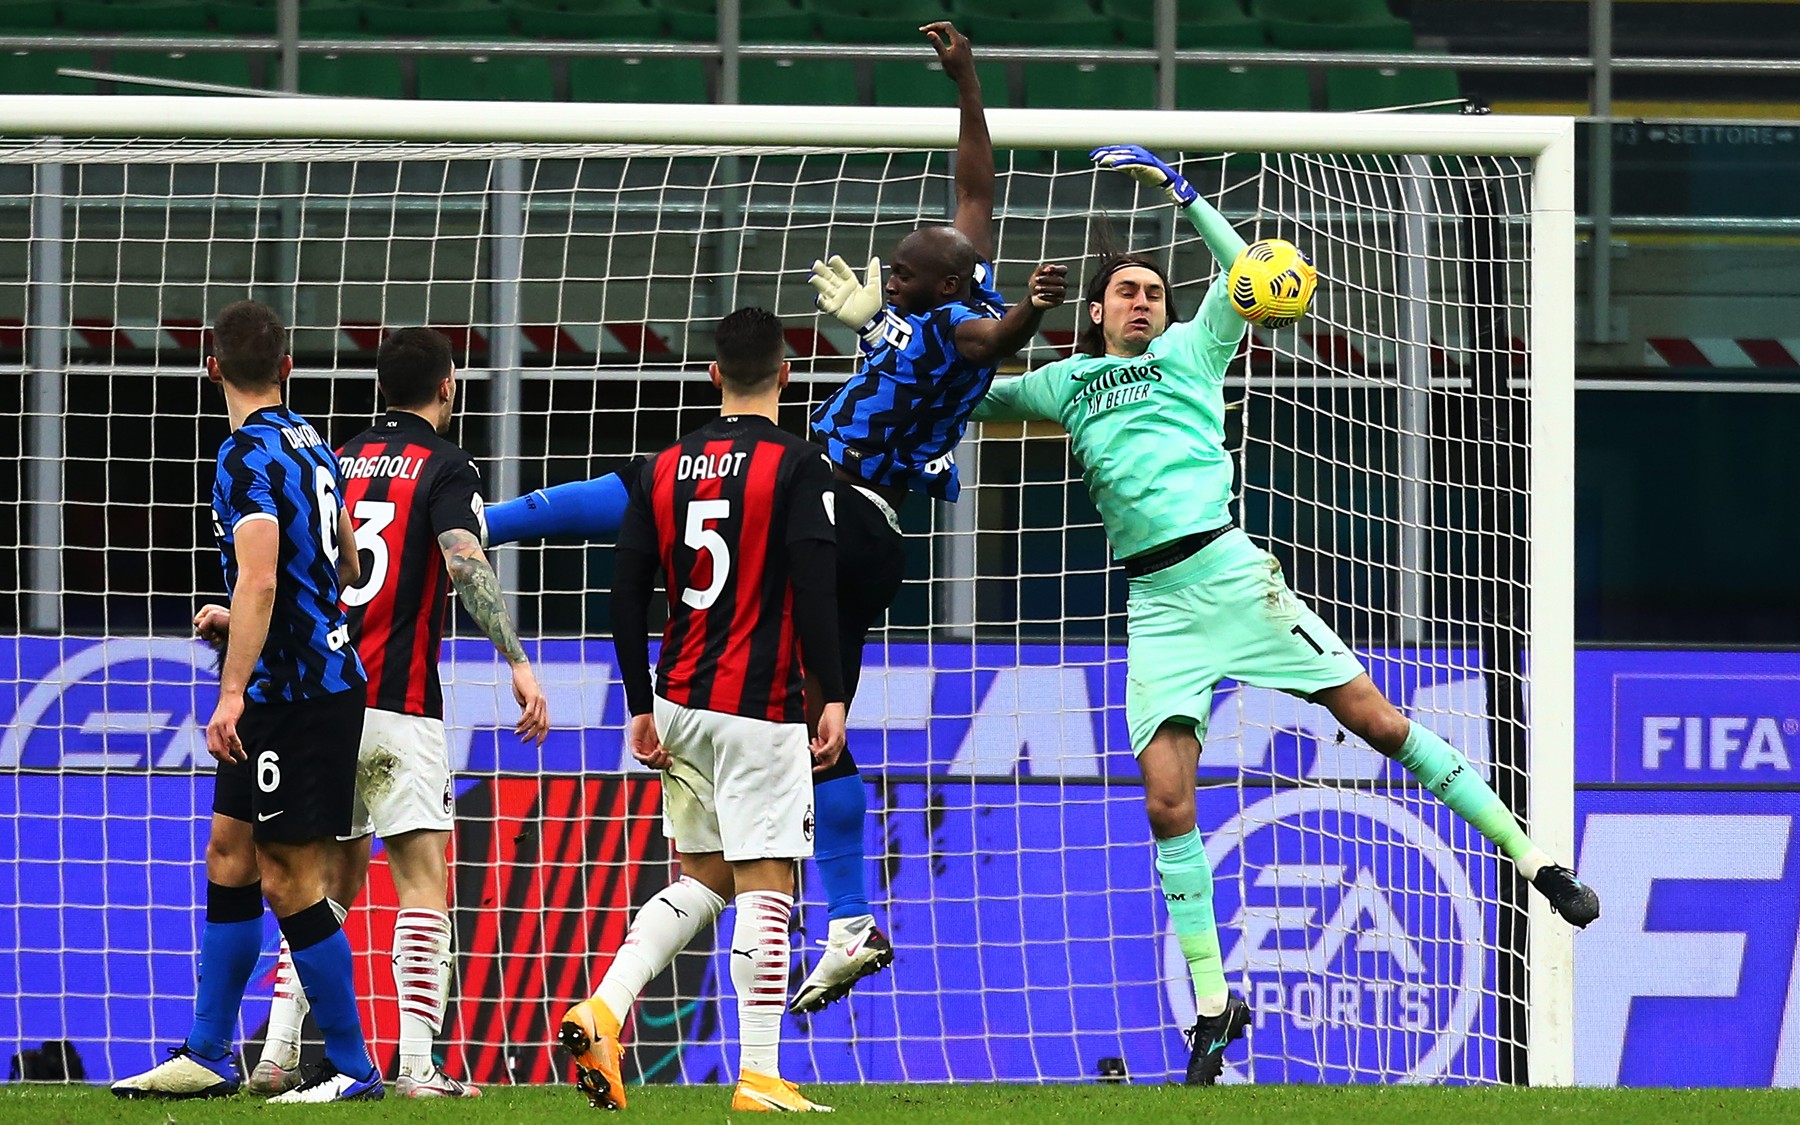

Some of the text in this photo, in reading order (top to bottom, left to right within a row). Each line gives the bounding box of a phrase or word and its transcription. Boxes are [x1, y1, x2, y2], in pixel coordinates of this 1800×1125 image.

[1667, 127, 1773, 145] SETTORE
[1106, 383, 1151, 410] BETTER
[338, 455, 424, 480] MAGNOLI
[677, 452, 747, 481] DALOT
[315, 465, 340, 568] 6
[339, 500, 397, 607] 3
[681, 499, 730, 610] 5
[1290, 624, 1325, 656] 1
[257, 750, 280, 793] 6
[1439, 764, 1465, 792] ACM
[1164, 892, 1186, 902] CM
[1223, 863, 1428, 974] EA
[1574, 813, 1800, 1087] F
